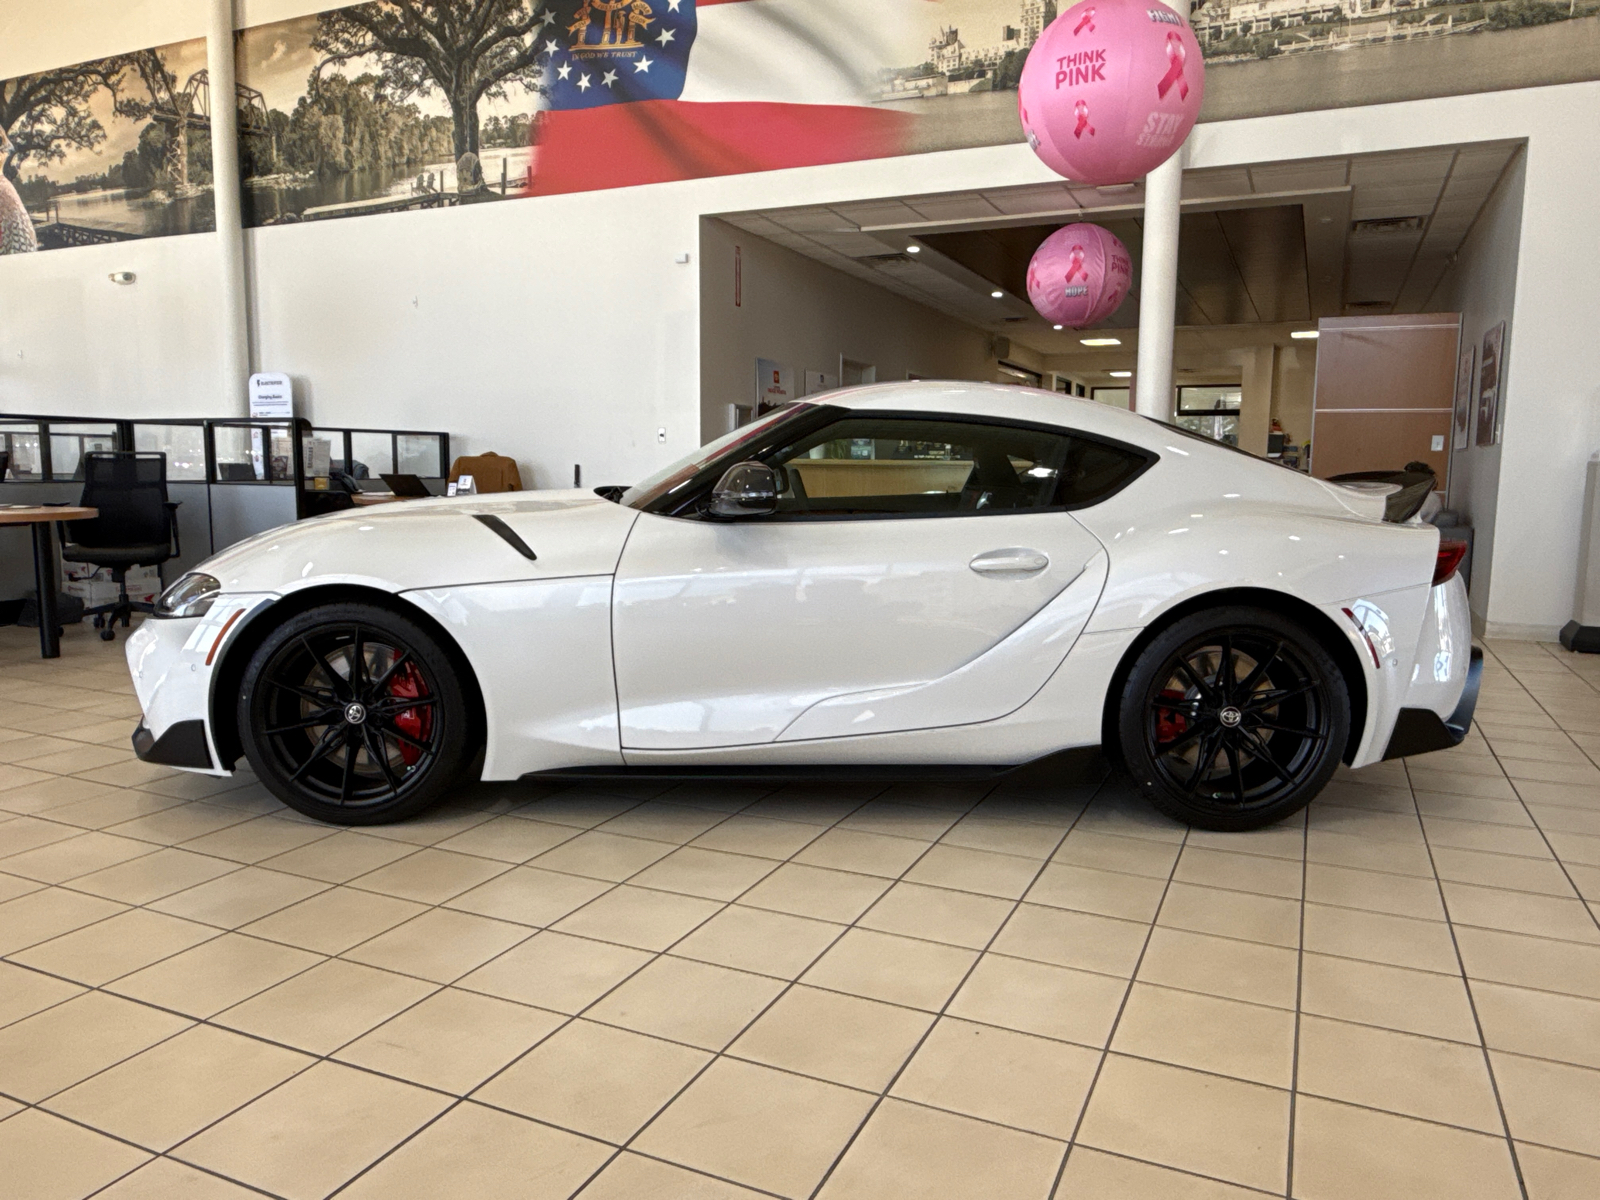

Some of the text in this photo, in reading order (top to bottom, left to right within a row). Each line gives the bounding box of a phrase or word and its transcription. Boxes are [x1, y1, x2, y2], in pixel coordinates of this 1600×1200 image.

[1057, 49, 1106, 71] THINK
[1056, 63, 1106, 90] PINK
[1143, 111, 1184, 134] STAY
[1065, 285, 1088, 298] HOPE
